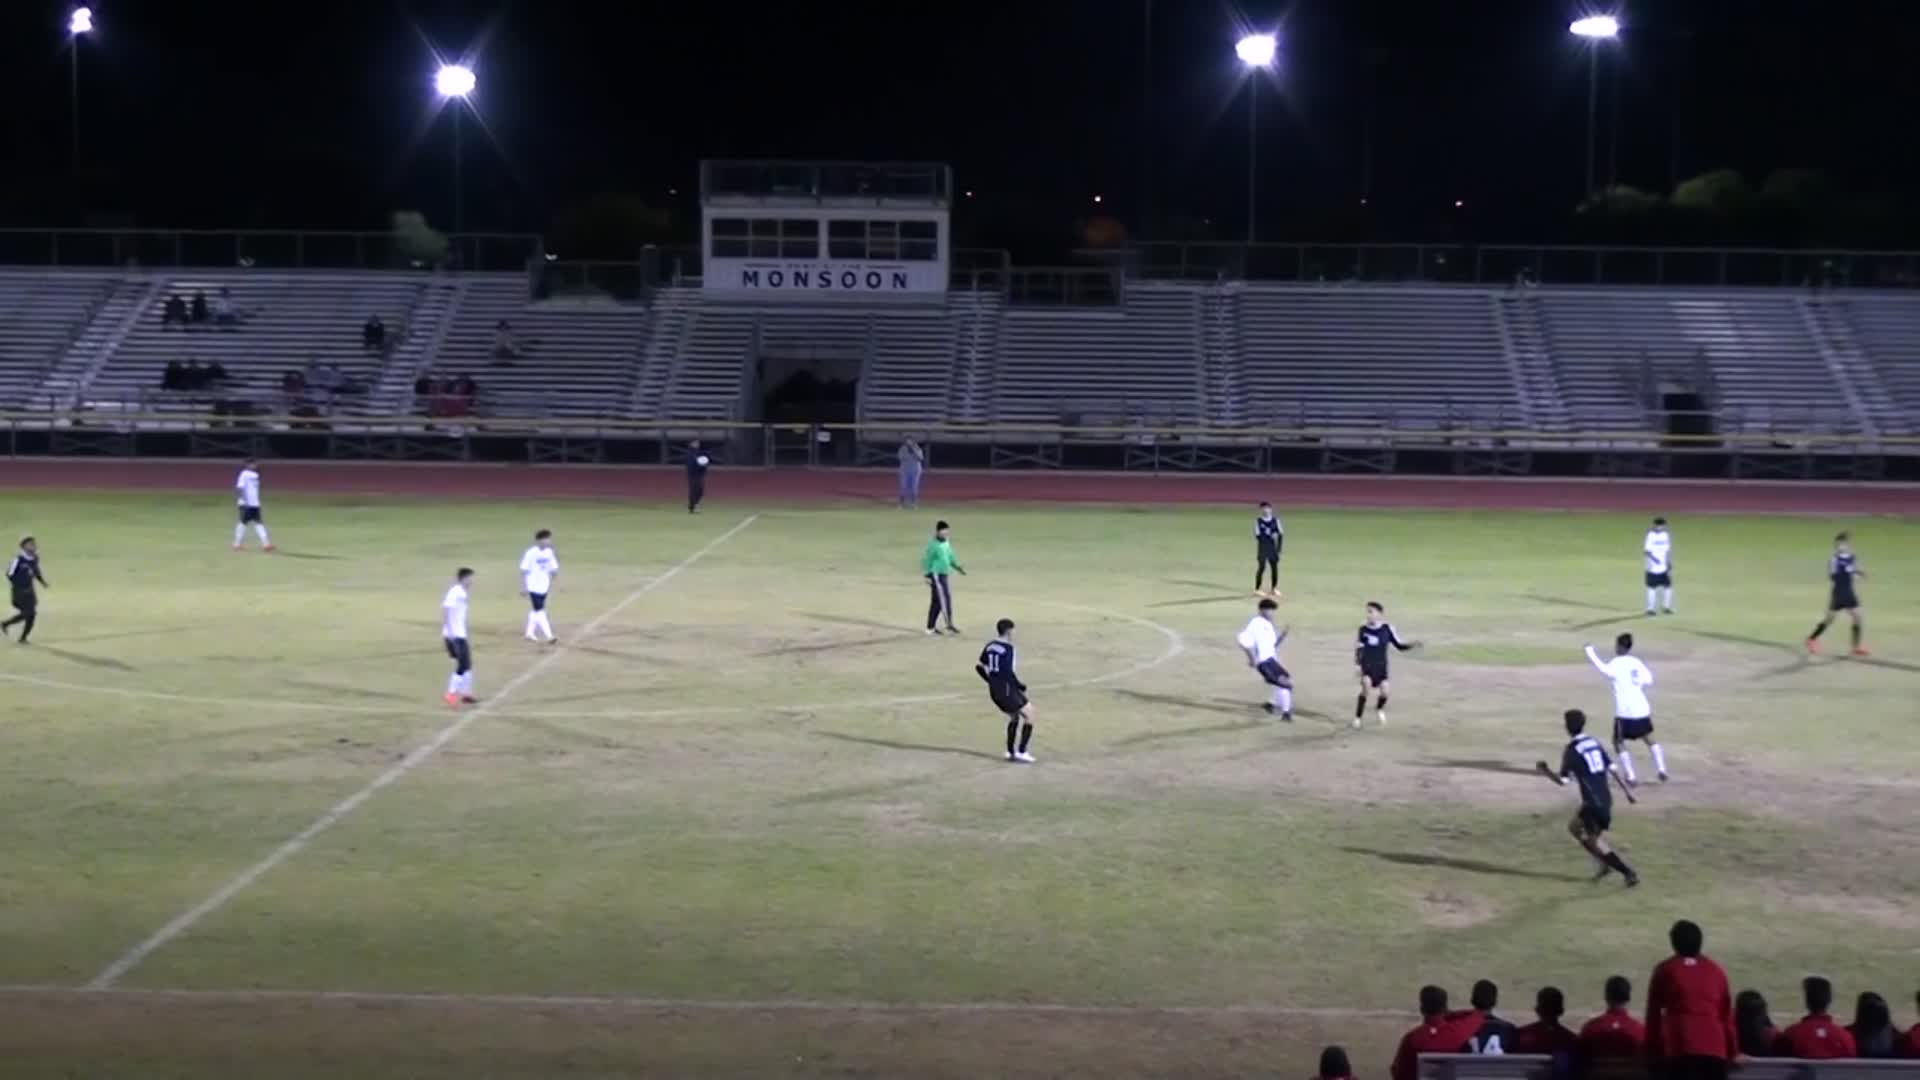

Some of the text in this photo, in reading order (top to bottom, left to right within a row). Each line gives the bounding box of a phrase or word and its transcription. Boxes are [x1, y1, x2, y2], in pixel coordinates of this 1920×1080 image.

[742, 270, 908, 289] MONSOON
[988, 653, 1000, 673] 11
[1470, 1034, 1505, 1055] 14
